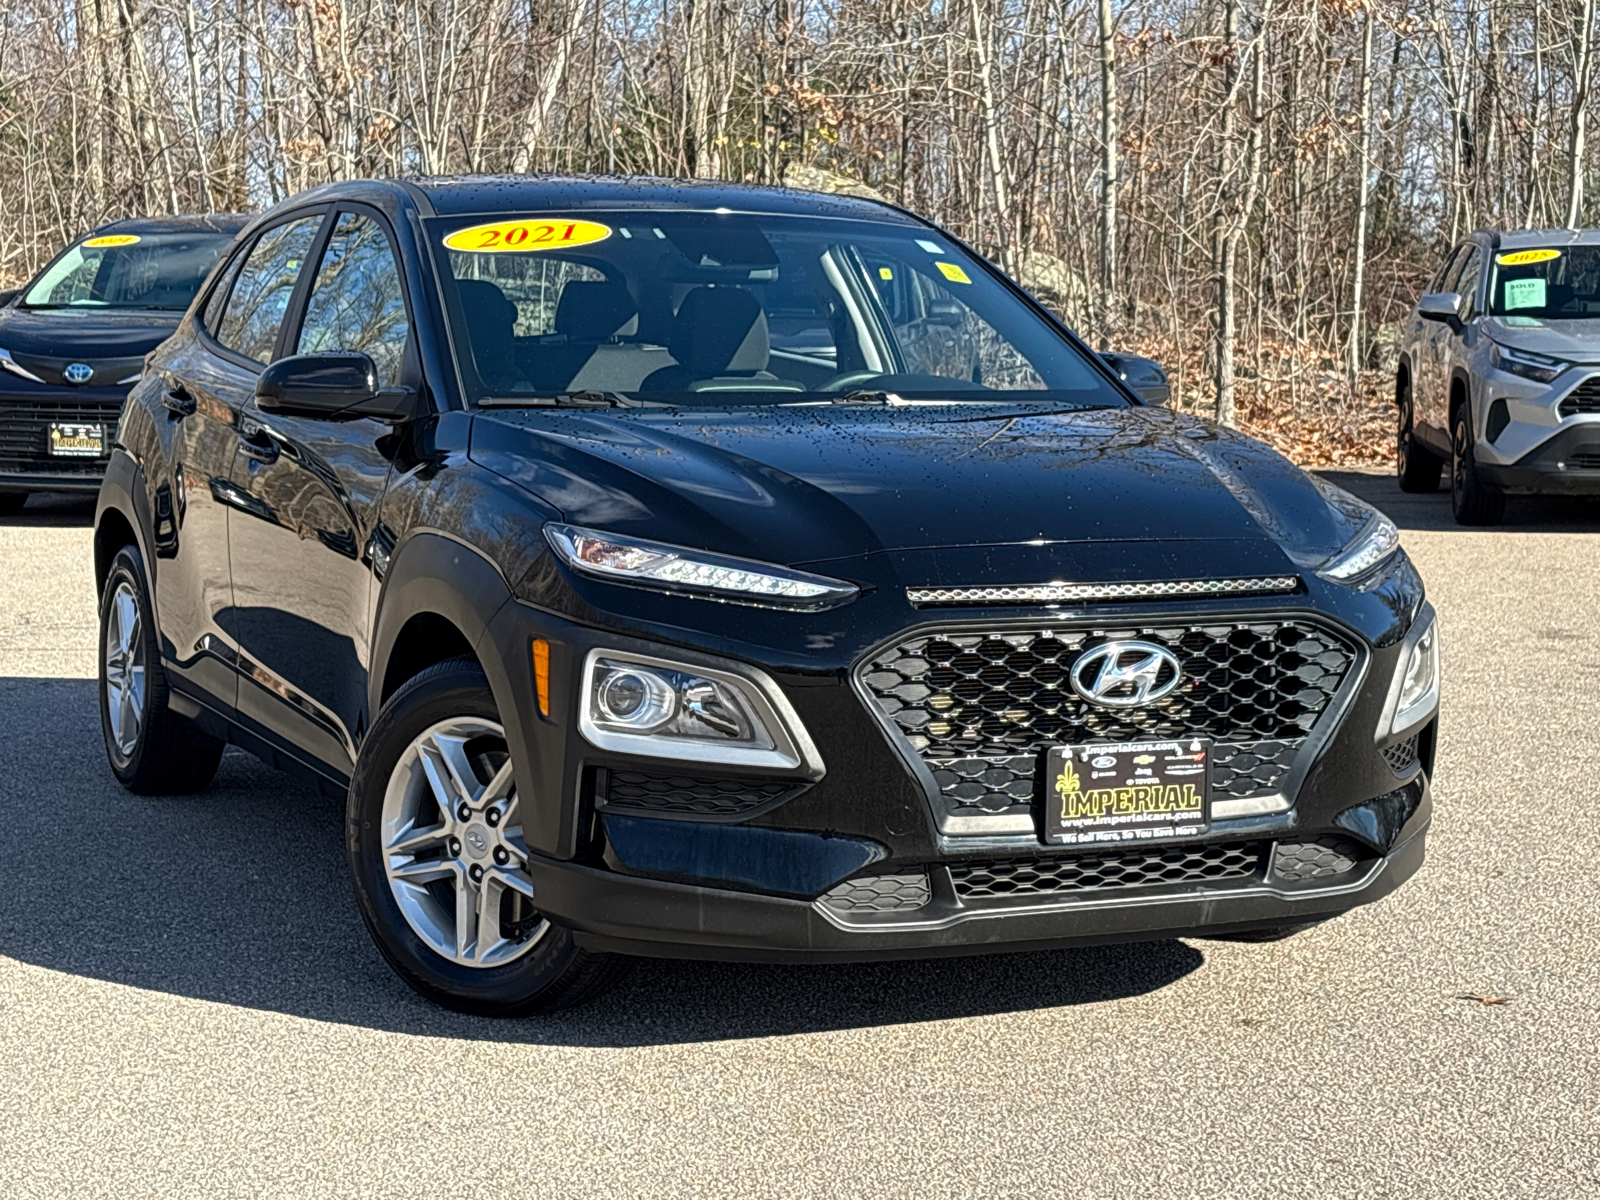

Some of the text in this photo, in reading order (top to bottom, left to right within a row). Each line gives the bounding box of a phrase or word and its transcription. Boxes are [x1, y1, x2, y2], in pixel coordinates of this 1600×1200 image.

[477, 223, 576, 249] 2021
[1135, 777, 1160, 785] TOYOTA
[1061, 784, 1201, 818] IMPERIAL
[1061, 811, 1201, 827] www.imperialcars.com
[1061, 826, 1197, 843] We Sell More, So You Save More
